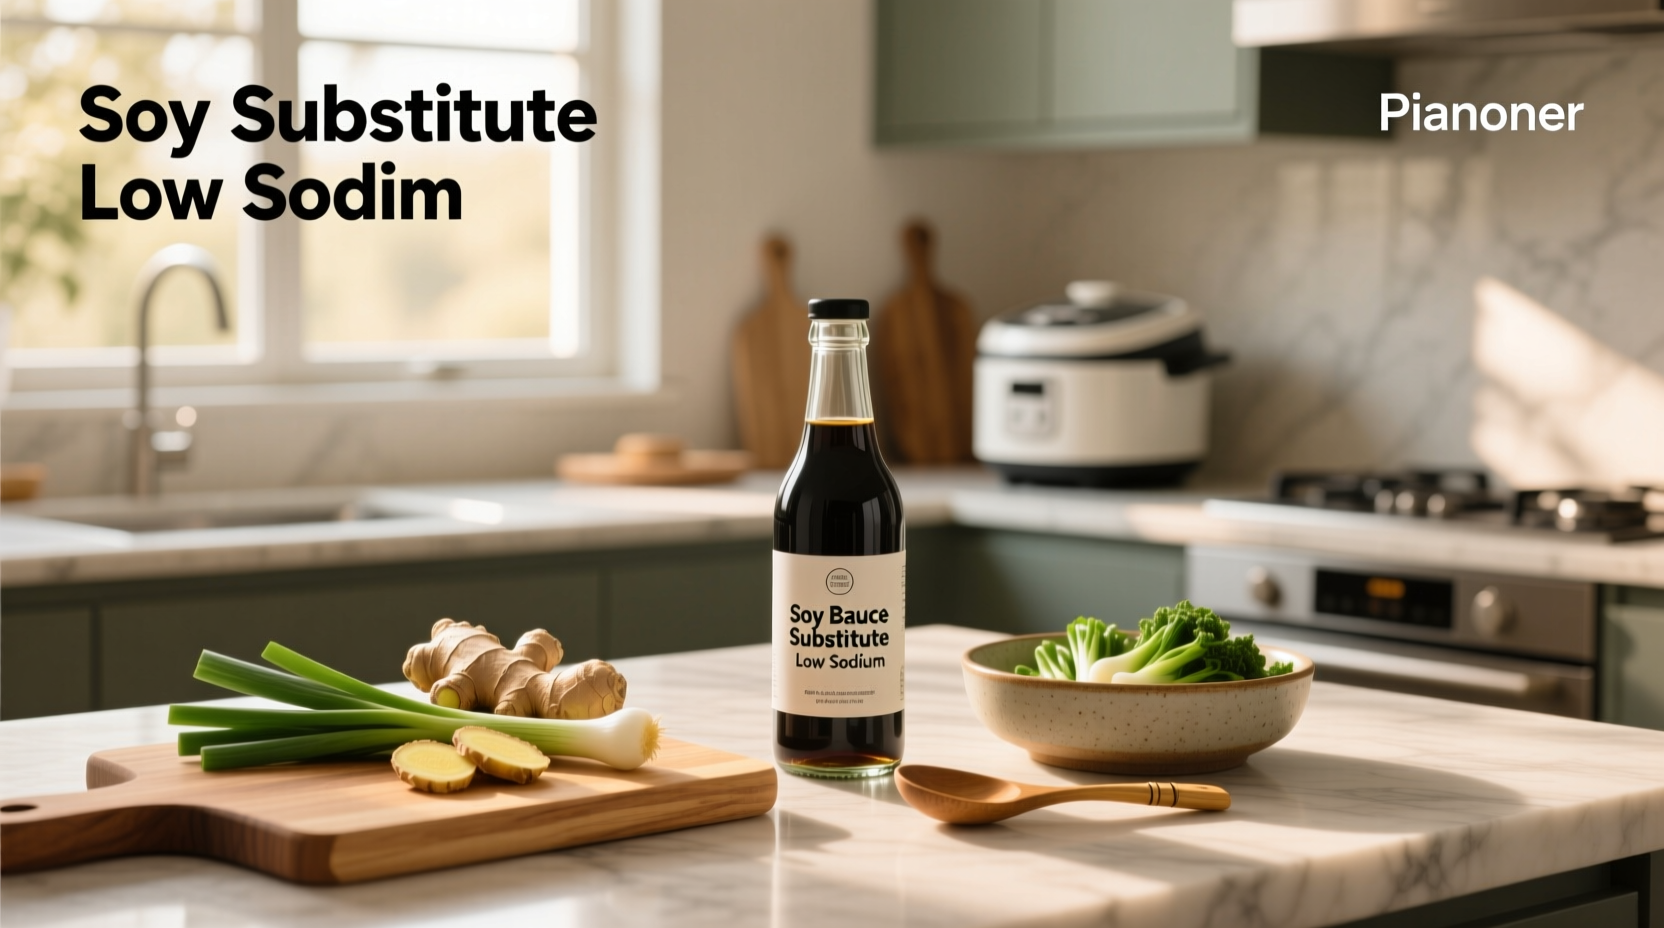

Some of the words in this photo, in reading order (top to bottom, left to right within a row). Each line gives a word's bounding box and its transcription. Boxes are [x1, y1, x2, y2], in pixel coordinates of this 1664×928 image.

[789, 603, 825, 629] Soy
[829, 605, 890, 625] Bauce
[789, 627, 890, 648] Substitute
[795, 652, 825, 669] Low
[829, 653, 886, 669] Sodium
